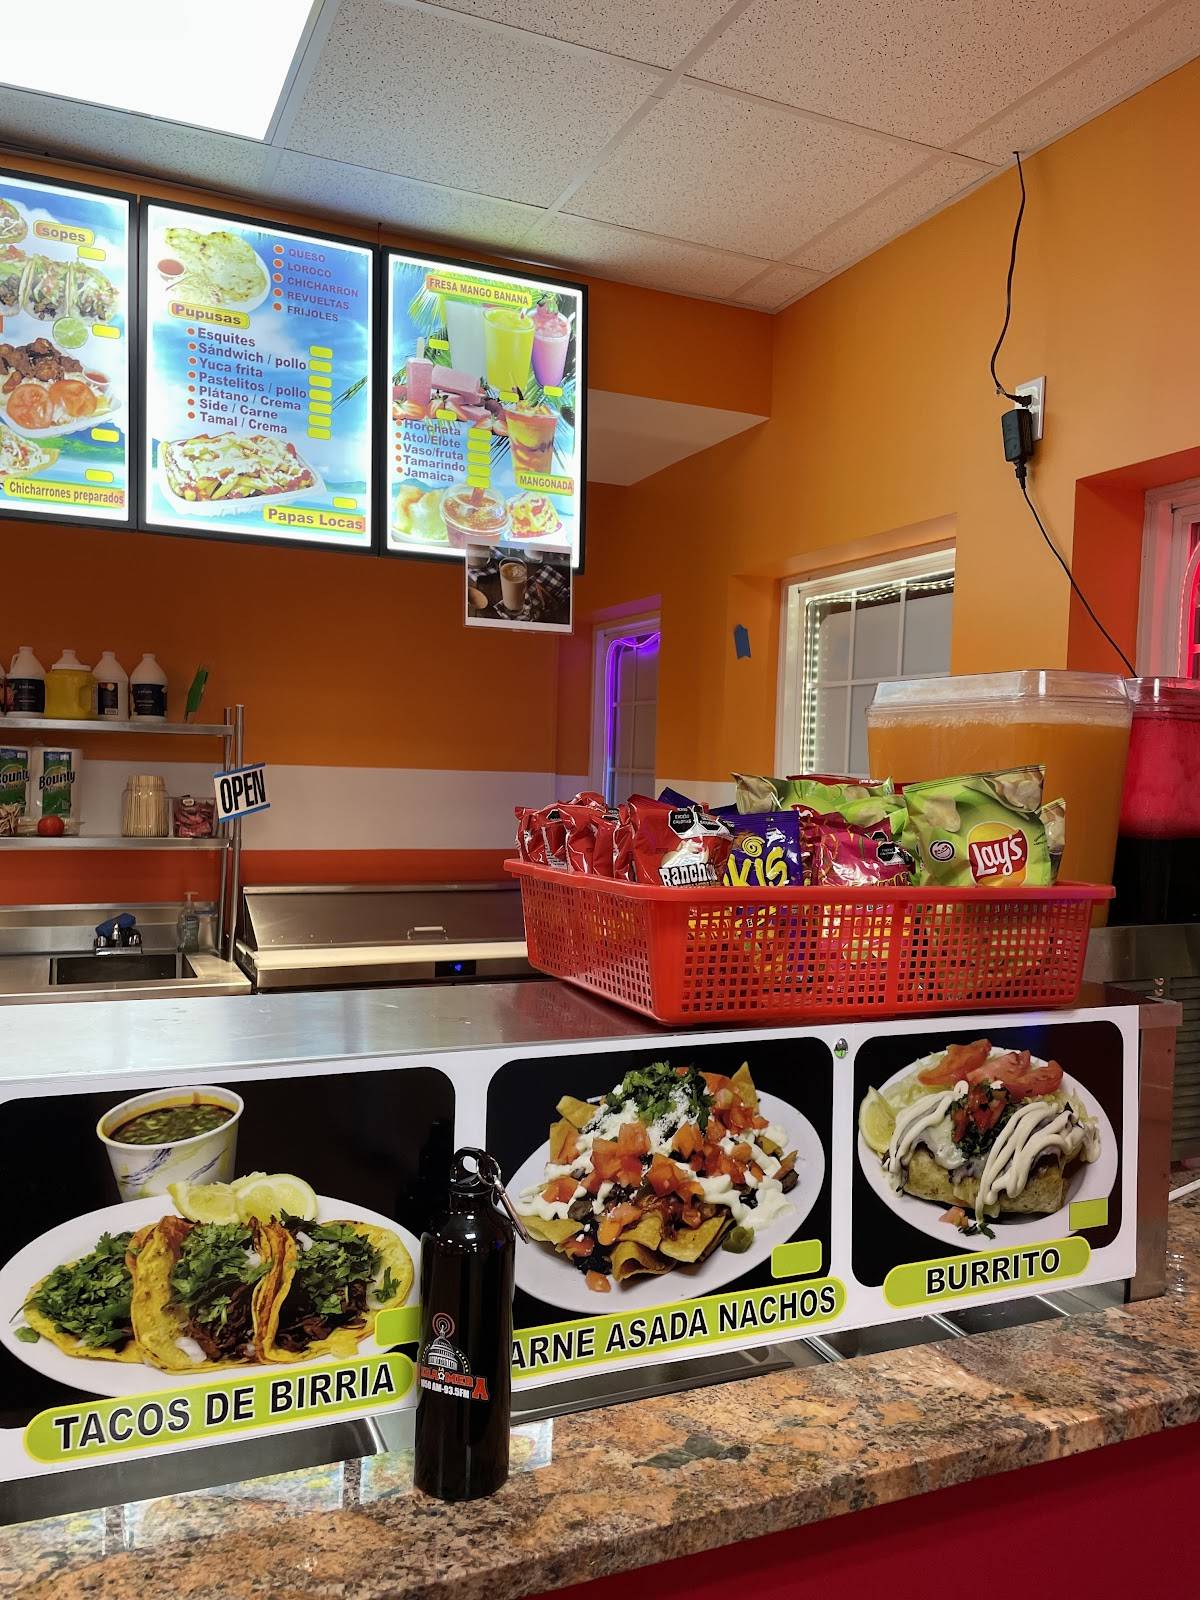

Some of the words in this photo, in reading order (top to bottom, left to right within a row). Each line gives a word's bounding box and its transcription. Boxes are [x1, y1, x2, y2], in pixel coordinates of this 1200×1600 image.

[42, 226, 86, 242] sopes
[288, 248, 326, 263] QUESO
[287, 263, 332, 278] LOROCO
[287, 277, 359, 298] CHICHARRON
[429, 278, 458, 292] FRESA
[460, 283, 492, 297] MANGO
[494, 290, 529, 305] BANANA
[287, 291, 350, 310] REVUELTAS
[175, 303, 242, 325] Pupusas
[287, 305, 339, 322] FRIJOLES
[198, 327, 256, 347] Esquites
[198, 342, 264, 363] Sándwich
[275, 356, 307, 370] pollo
[199, 357, 232, 373] Yuca
[236, 363, 264, 378] frita
[199, 371, 265, 392] Pastelitos
[276, 386, 307, 399] pollo
[199, 386, 249, 403] Plátano
[260, 395, 301, 411] Crema
[199, 398, 229, 412] Side
[240, 404, 278, 419] Carne
[200, 411, 238, 427] Tamal
[248, 419, 288, 434] Crema
[404, 420, 461, 436] Horchata
[403, 431, 461, 448] Atol/Elote
[403, 443, 464, 460] Vaso/fruta
[403, 455, 466, 472] Tamarindo
[404, 467, 454, 482] Jamaica
[520, 475, 573, 490] MANGONADA
[9, 481, 71, 498] Chicharrones
[73, 490, 125, 504] preparados
[268, 508, 314, 524] Papas
[319, 513, 363, 529] Locas
[0, 769, 30, 784] ounty
[39, 770, 76, 790] Bounty
[220, 769, 267, 814] OPEN
[971, 833, 1023, 876] Lay's
[659, 862, 718, 887] Ranch
[926, 1248, 1060, 1296] BURRITO
[512, 1327, 595, 1369] ARNE
[605, 1308, 709, 1353] ASADA
[718, 1285, 836, 1333] NACHOS
[53, 1398, 191, 1451] TACOS
[205, 1386, 255, 1427] DE
[269, 1363, 395, 1414] BIRRIA
